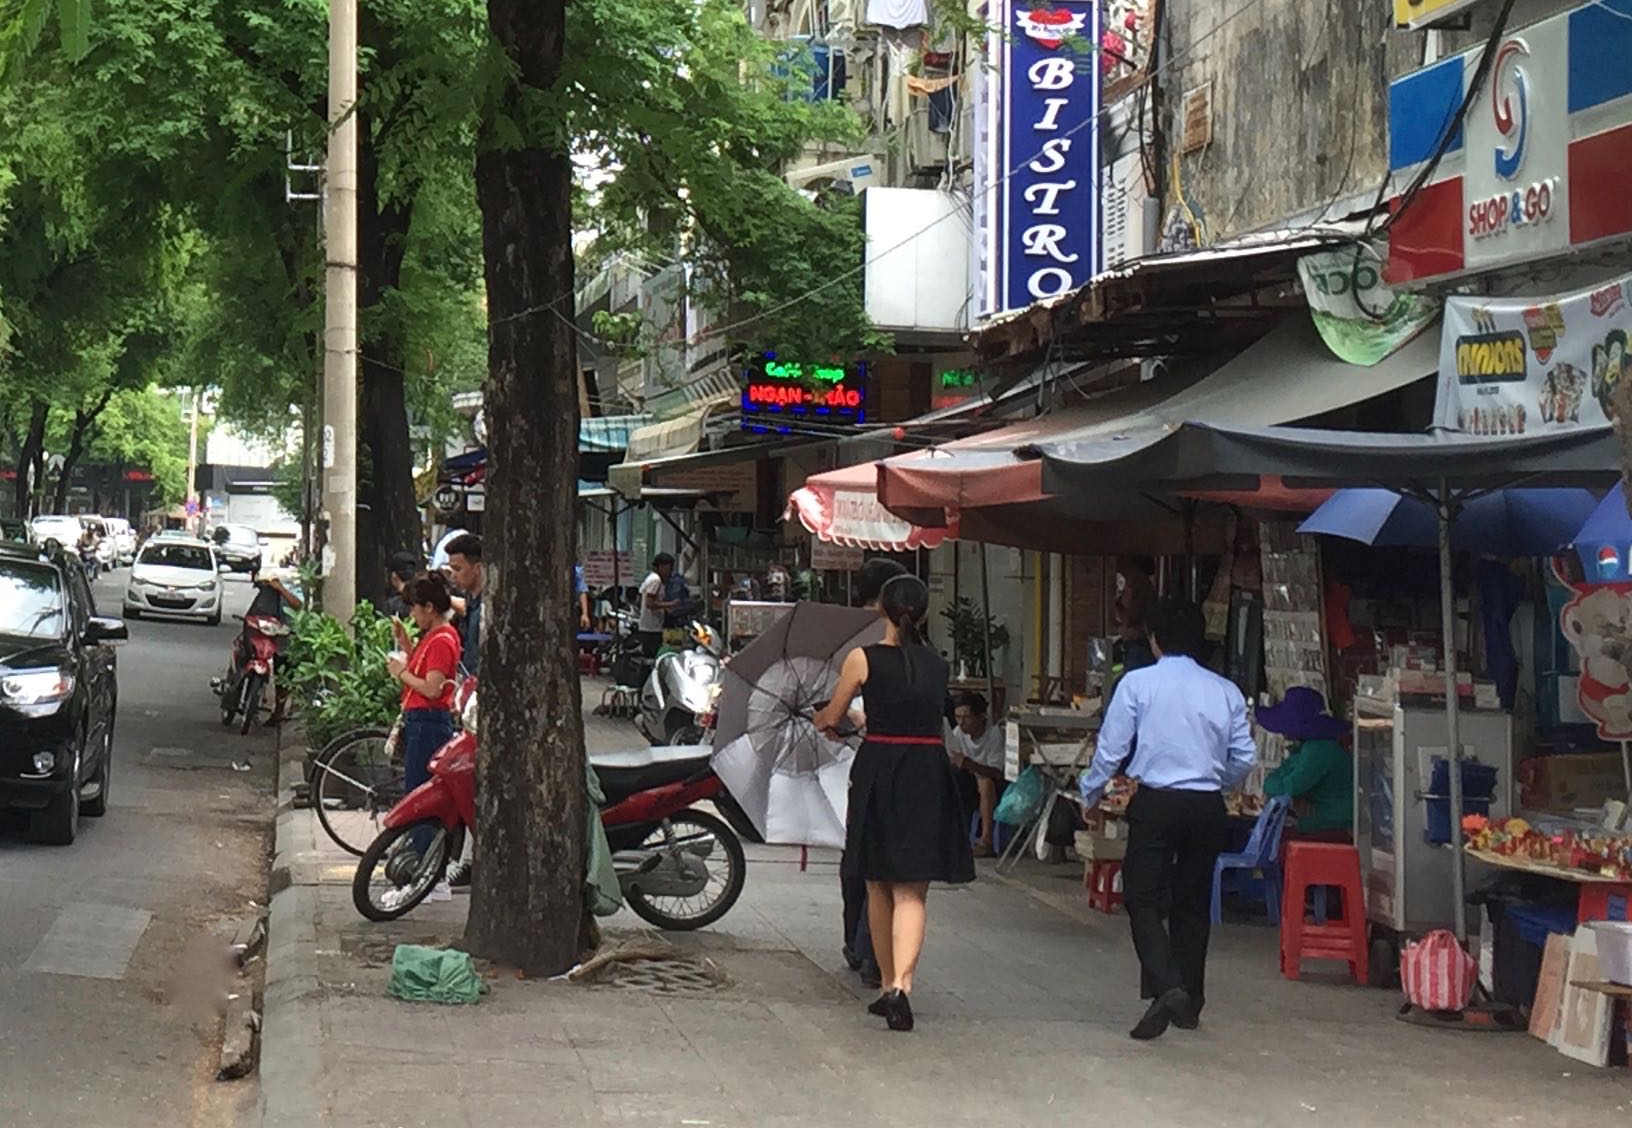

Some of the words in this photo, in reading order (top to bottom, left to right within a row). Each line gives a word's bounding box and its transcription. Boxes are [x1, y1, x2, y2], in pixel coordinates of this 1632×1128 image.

[1021, 58, 1079, 300] BISTRO
[1469, 195, 1508, 235] SHOP
[1511, 190, 1522, 224] &
[1524, 182, 1551, 222] GO
